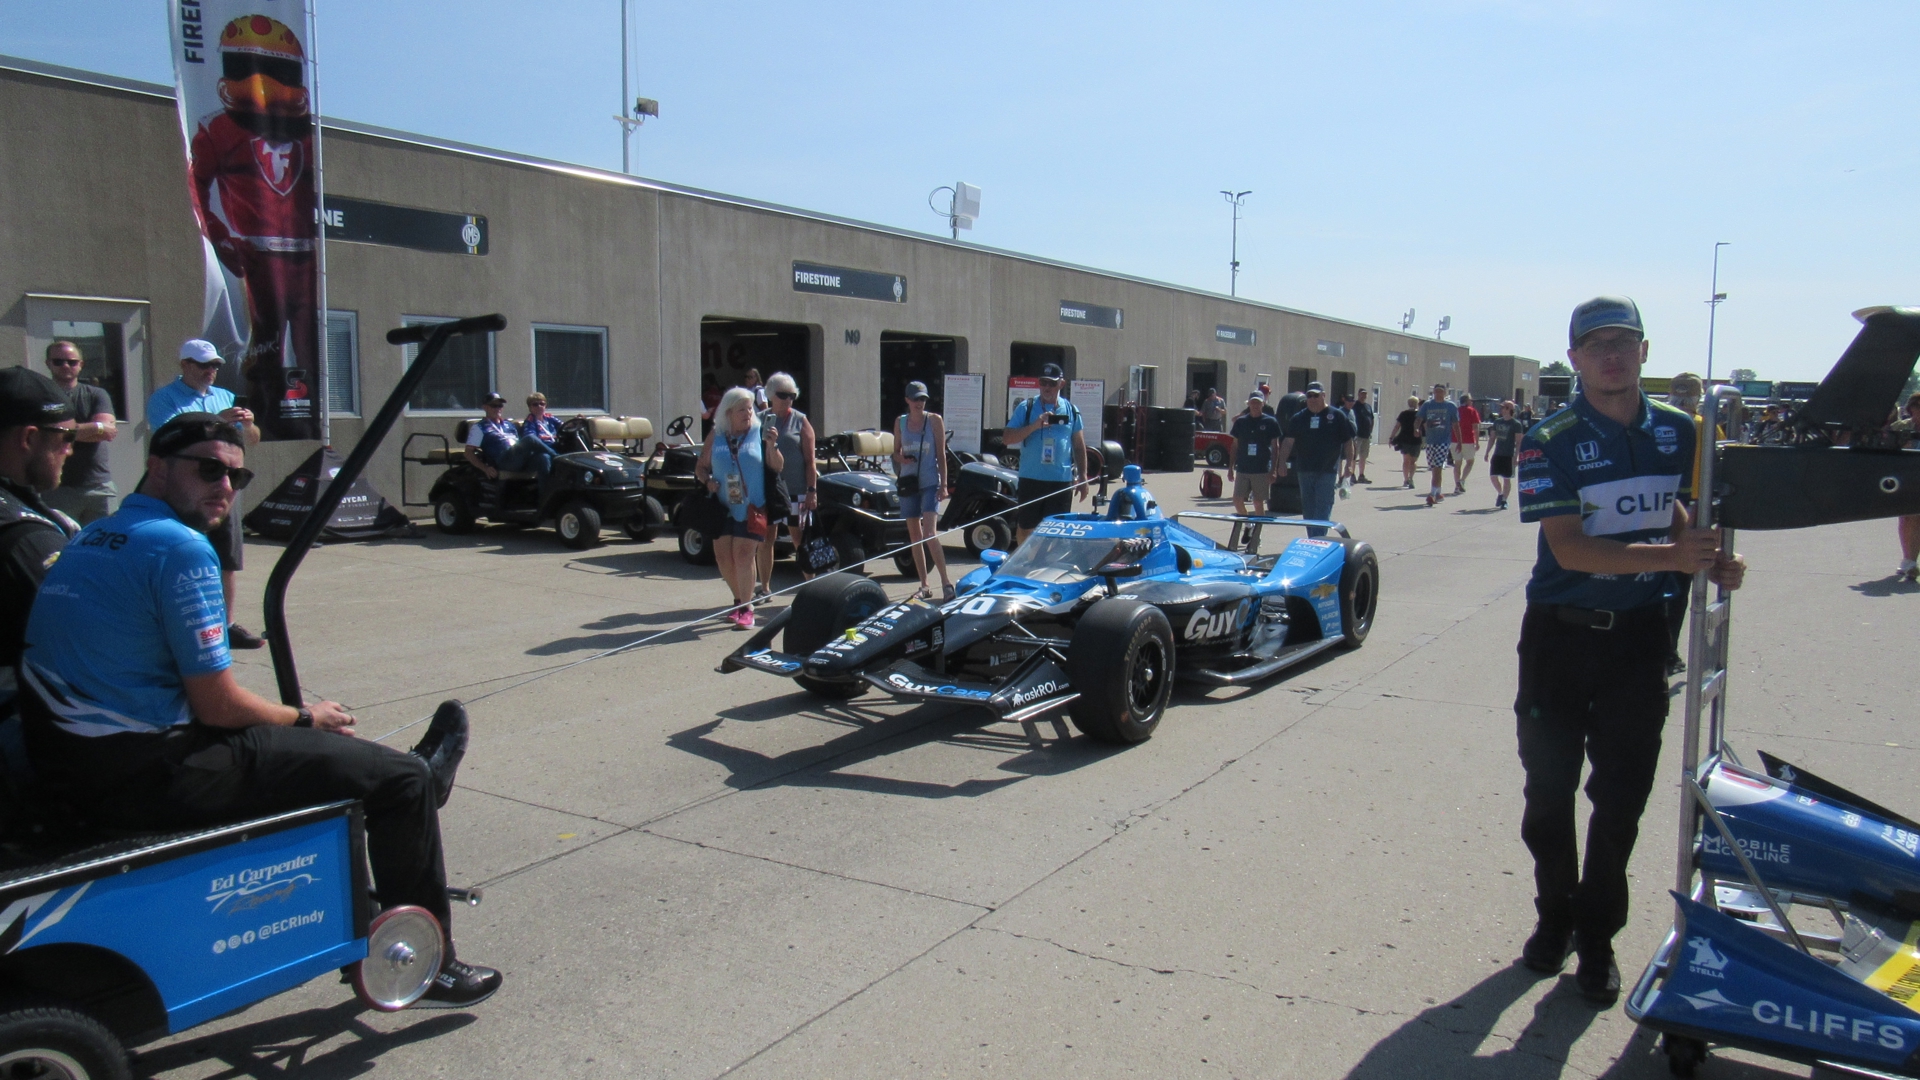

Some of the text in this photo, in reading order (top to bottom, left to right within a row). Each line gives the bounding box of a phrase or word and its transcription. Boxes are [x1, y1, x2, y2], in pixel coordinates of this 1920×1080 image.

[795, 271, 841, 288] FIRESTONE
[1060, 307, 1086, 319] FIRESTONE
[845, 329, 860, 345] N9
[1577, 459, 1613, 471] ONDA
[1616, 492, 1674, 515] CLIF
[1035, 527, 1086, 537] BOLD
[1040, 521, 1093, 530] DIANA
[74, 528, 128, 550] Care
[888, 673, 992, 698] GuyCare
[211, 853, 318, 893] Ed Carpenter
[258, 909, 325, 940] @ECRIndy
[1689, 964, 1725, 979] STELLA
[1752, 1000, 1905, 1050] CLIFFS
